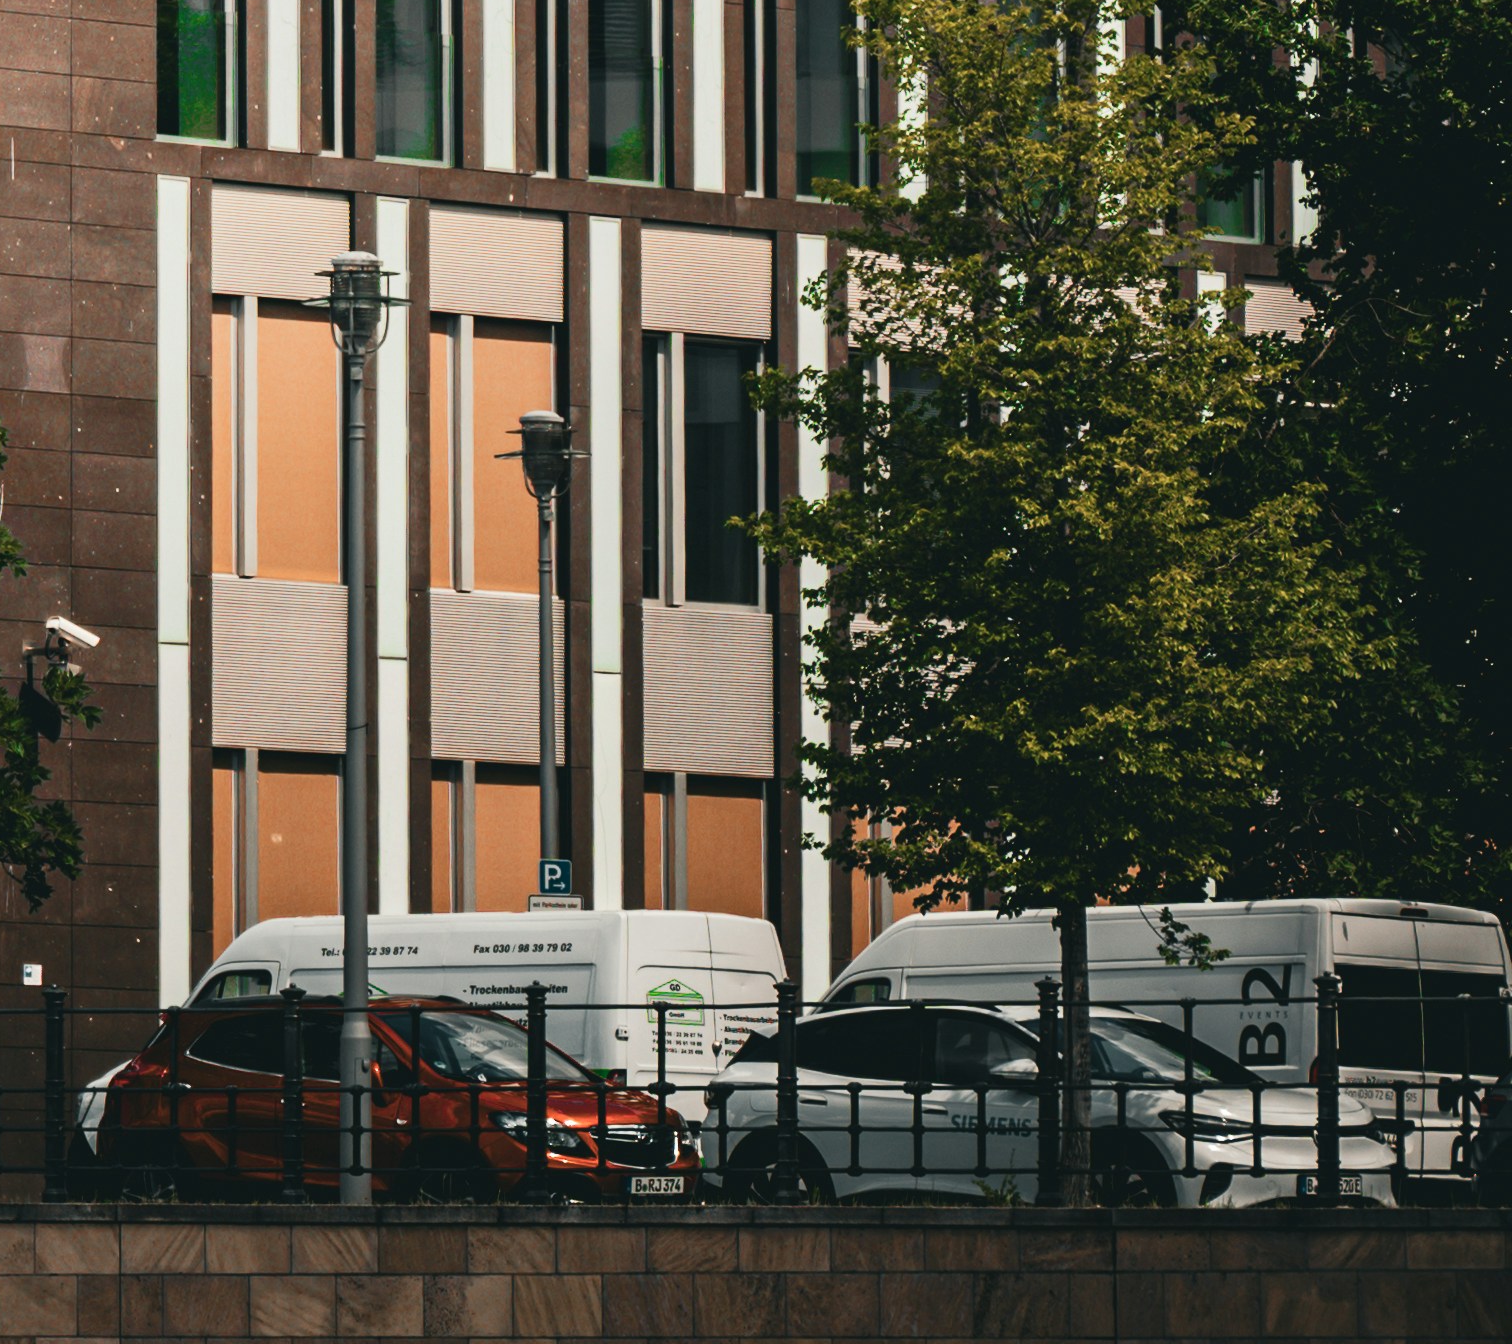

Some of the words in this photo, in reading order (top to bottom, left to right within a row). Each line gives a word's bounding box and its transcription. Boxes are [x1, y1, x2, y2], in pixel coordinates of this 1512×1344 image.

[544, 863, 562, 890] P
[379, 946, 391, 956] 39
[393, 946, 405, 955] 87
[407, 946, 419, 955] 74
[473, 944, 490, 954] Fax
[492, 944, 511, 953] 030
[517, 944, 530, 953] 98
[532, 943, 545, 952] 39
[547, 943, 559, 952] 79
[560, 942, 573, 952] 02
[470, 984, 568, 995] Trockenbaiten
[1239, 1011, 1289, 1020] EVENTS
[1375, 1090, 1384, 1100] 72
[951, 1114, 1032, 1138] SIEMENS
[648, 1178, 661, 1192] RJ
[663, 1178, 681, 1192] 374
